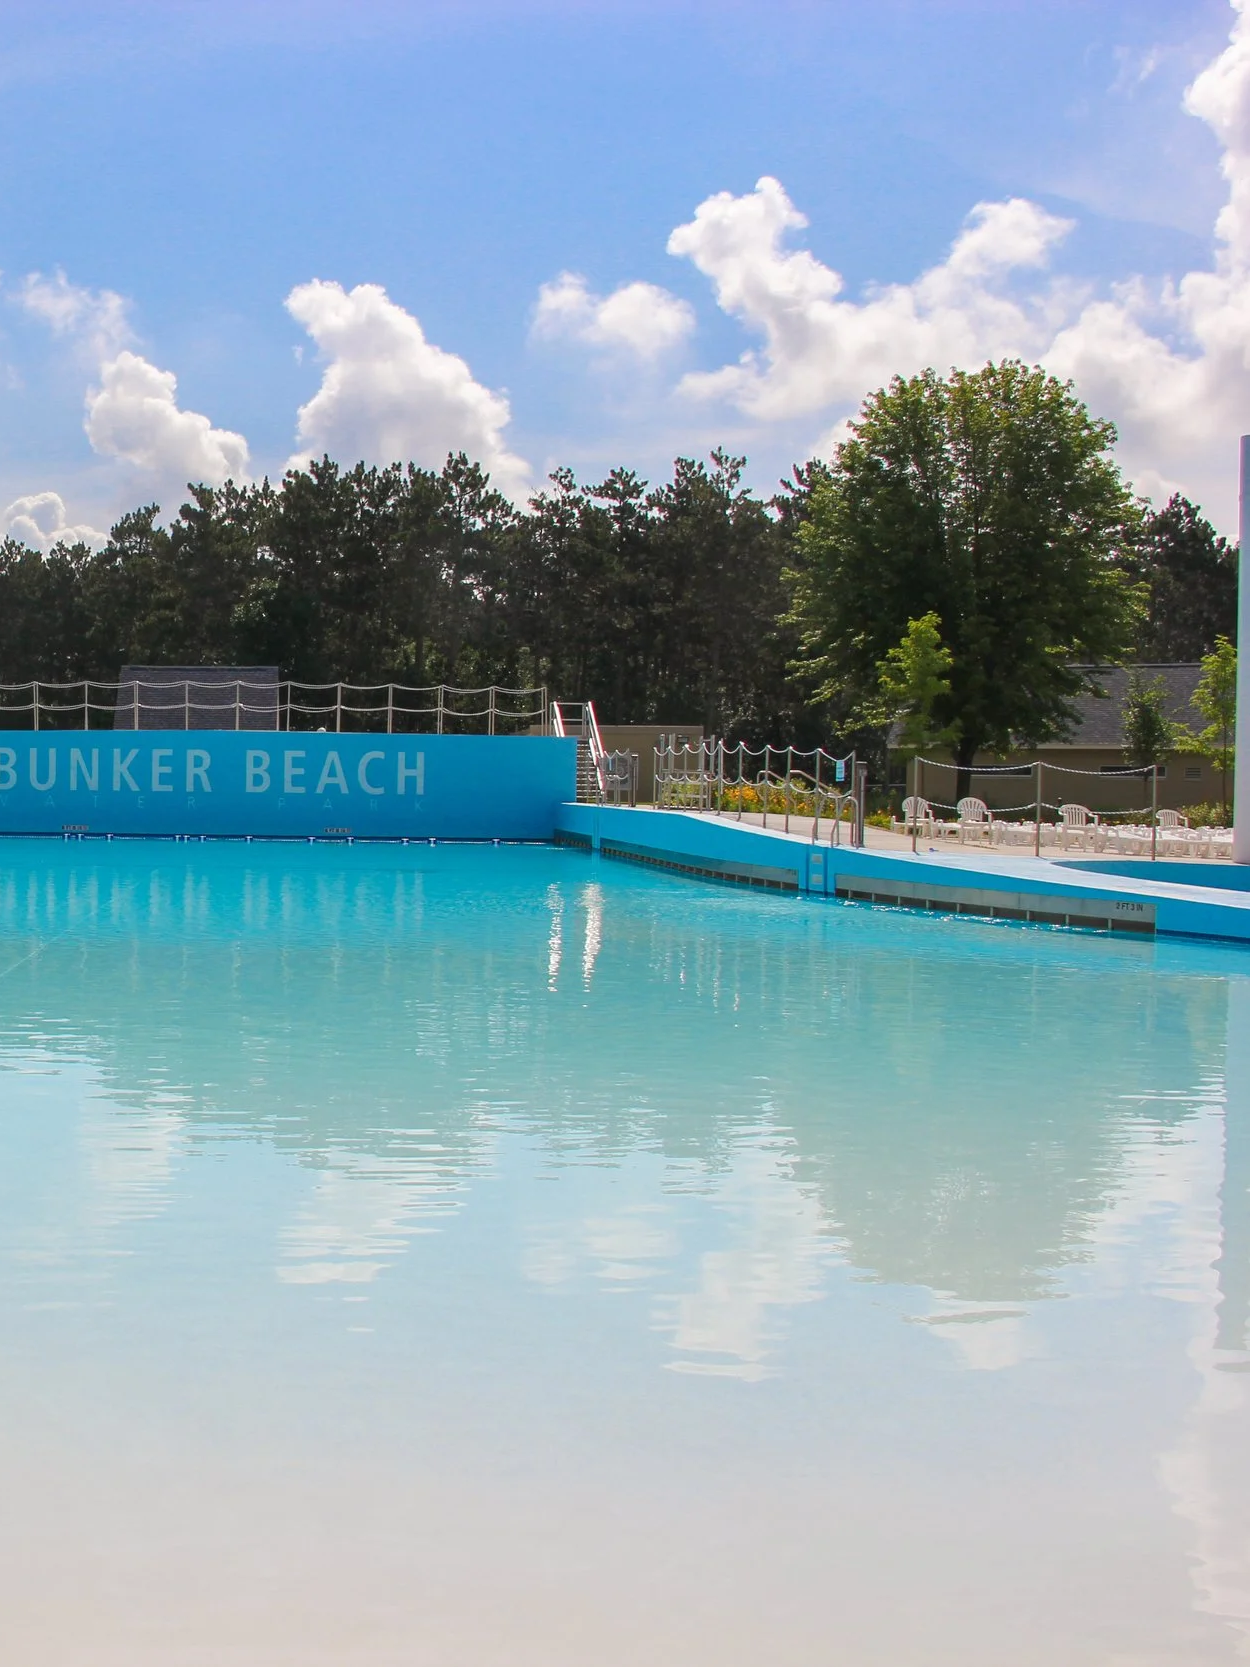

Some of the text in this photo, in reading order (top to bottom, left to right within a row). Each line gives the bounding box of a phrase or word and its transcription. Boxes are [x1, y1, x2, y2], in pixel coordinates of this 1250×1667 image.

[245, 749, 425, 795] BEACH
[278, 798, 424, 812] PARK
[1116, 902, 1120, 910] 2
[1121, 902, 1129, 910] FT
